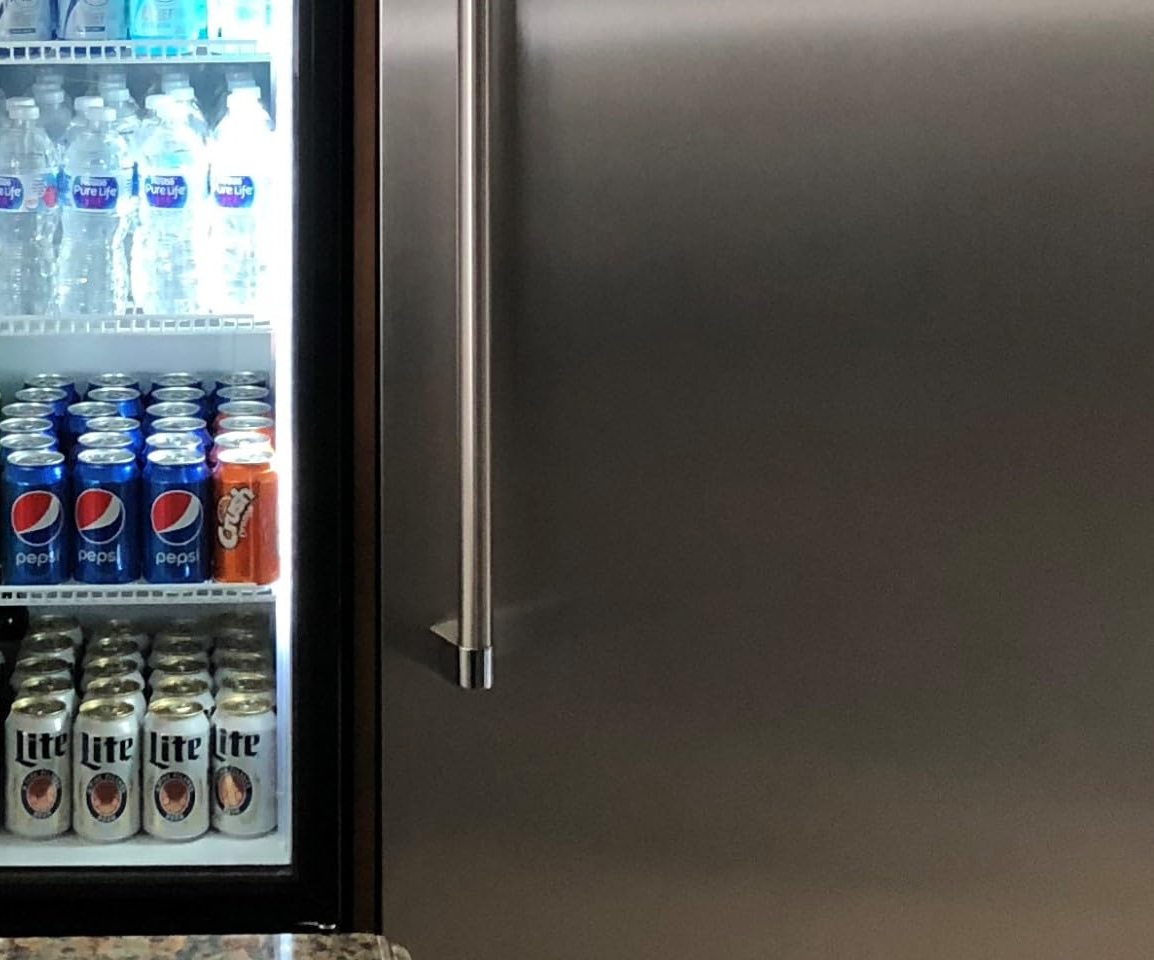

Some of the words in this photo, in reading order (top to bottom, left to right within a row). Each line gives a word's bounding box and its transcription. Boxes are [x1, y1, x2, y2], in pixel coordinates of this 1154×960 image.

[4, 185, 22, 201] Life
[73, 185, 97, 197] Pure
[98, 185, 117, 200] Life
[145, 183, 166, 195] Pure
[167, 184, 186, 199] Life
[234, 184, 253, 200] Life
[15, 549, 61, 567] pepi
[78, 548, 121, 566] peps
[155, 548, 200, 567] pepsi
[15, 730, 68, 767] Lite
[81, 731, 134, 771] Lite
[149, 730, 202, 770] Lite
[210, 724, 261, 762] Lite
